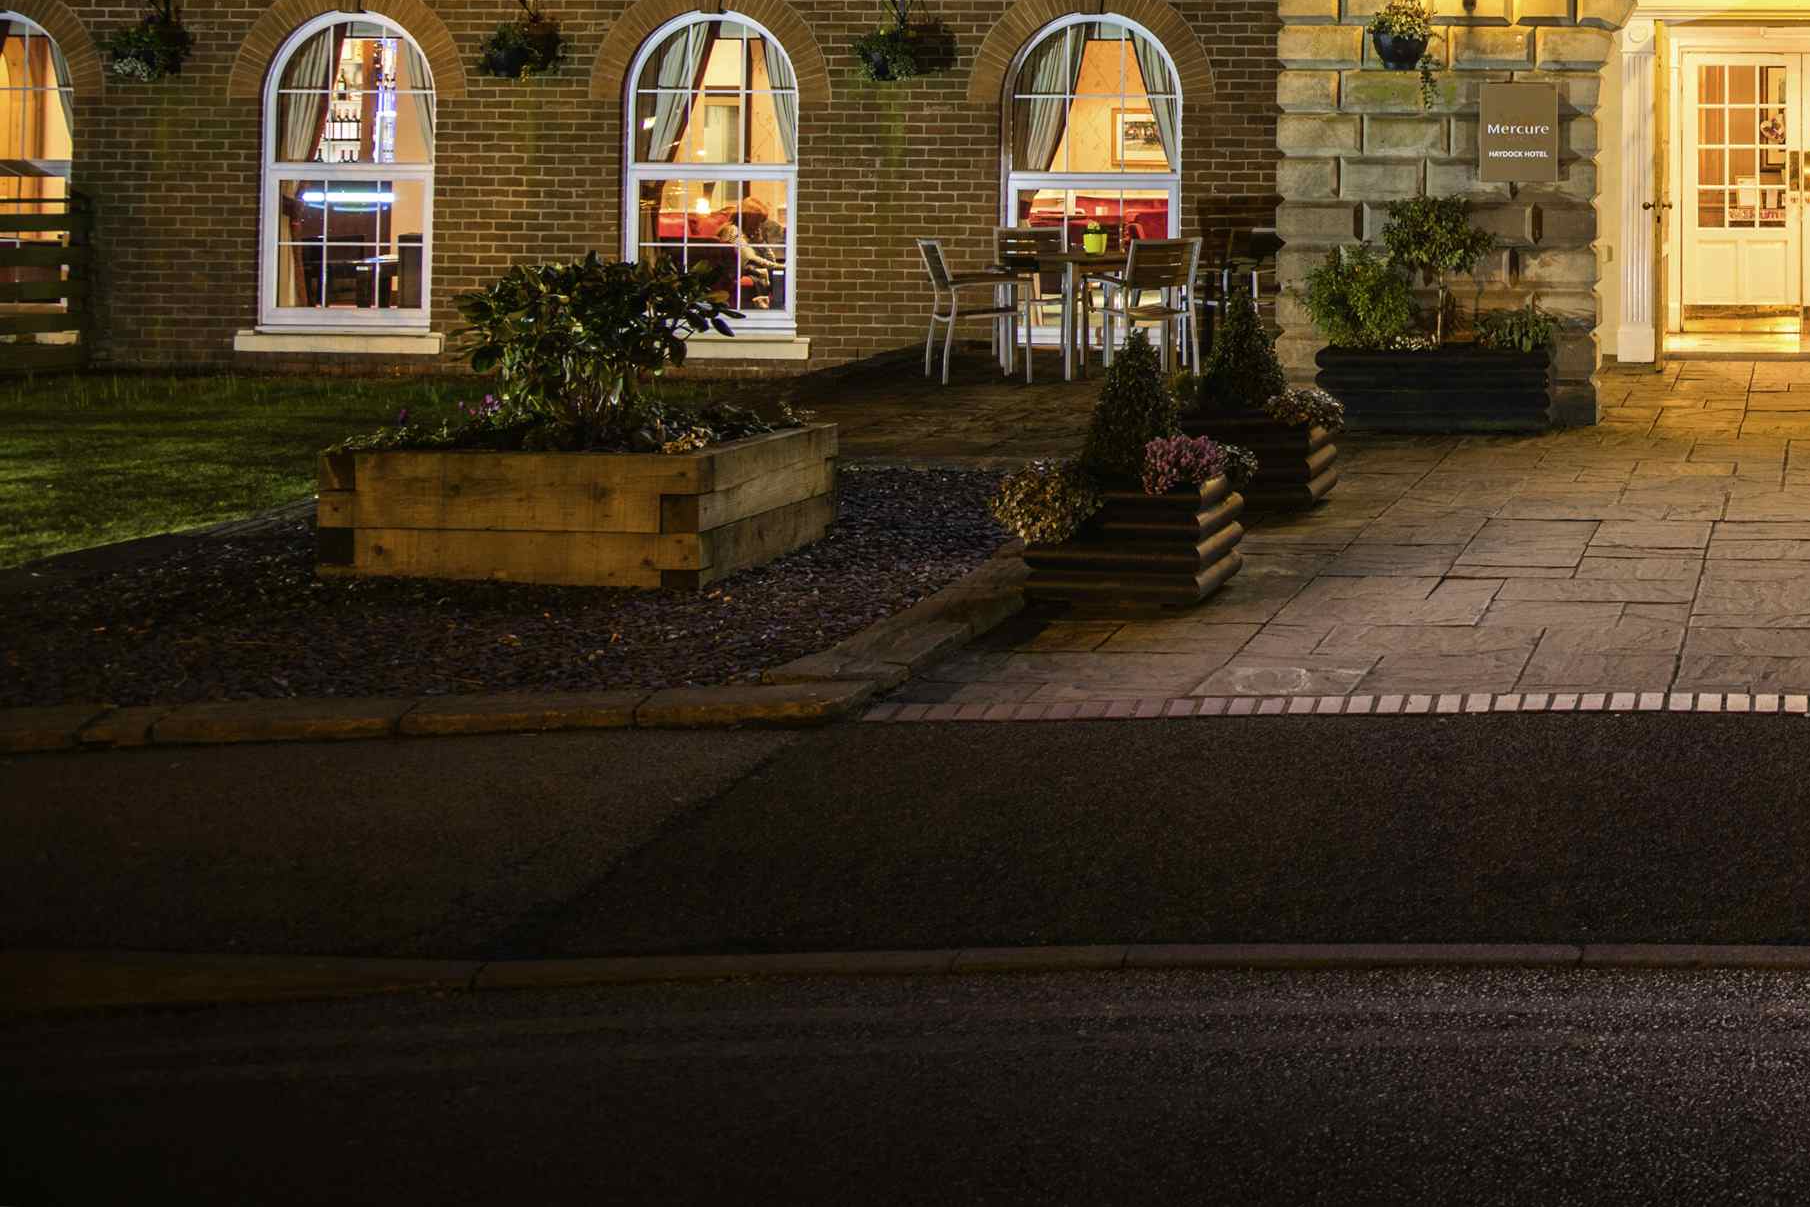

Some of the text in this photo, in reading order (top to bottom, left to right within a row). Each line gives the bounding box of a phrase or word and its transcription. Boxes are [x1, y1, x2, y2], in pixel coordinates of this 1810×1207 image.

[1487, 124, 1549, 134] Mercure
[1488, 150, 1549, 158] HAYDOCK HOTEL
